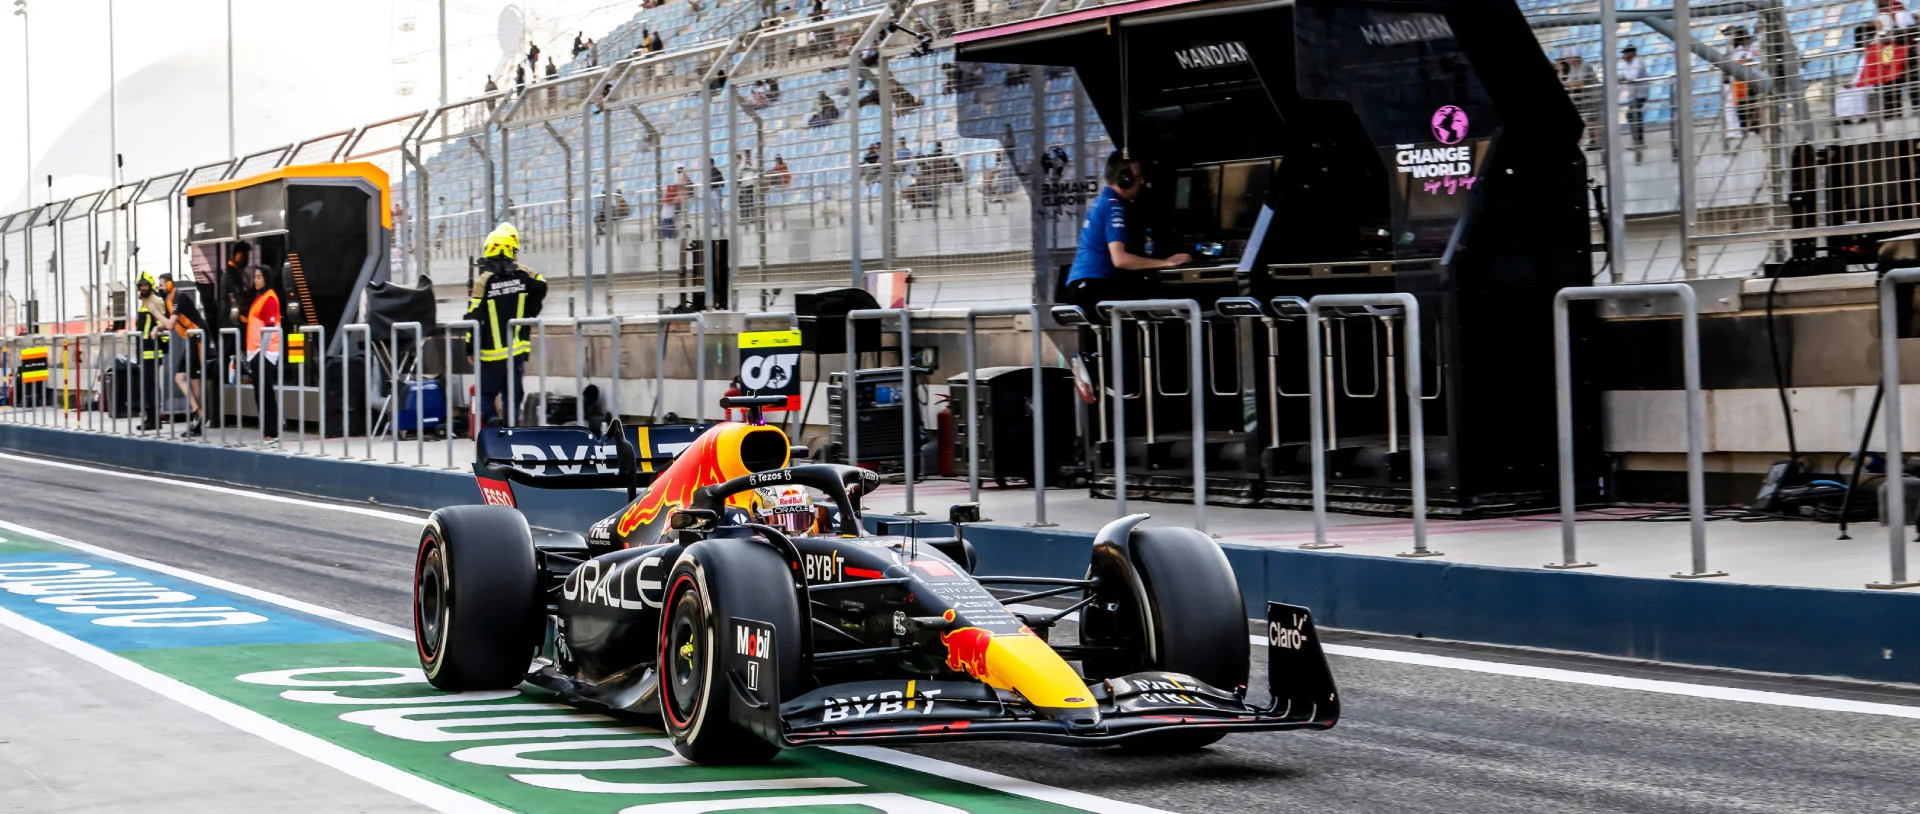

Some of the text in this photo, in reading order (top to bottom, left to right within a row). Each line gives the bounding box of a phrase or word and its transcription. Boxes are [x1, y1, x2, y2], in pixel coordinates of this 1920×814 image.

[1396, 147, 1469, 165] CHANGE
[1411, 162, 1471, 178] WORLD
[757, 472, 782, 482] Tezos
[483, 487, 513, 508] ESSO
[774, 505, 810, 514] ORACLE
[806, 549, 844, 583] BYBIT
[563, 556, 663, 610] ORACLE
[736, 625, 771, 660] Mobil
[1269, 619, 1302, 651] Claro
